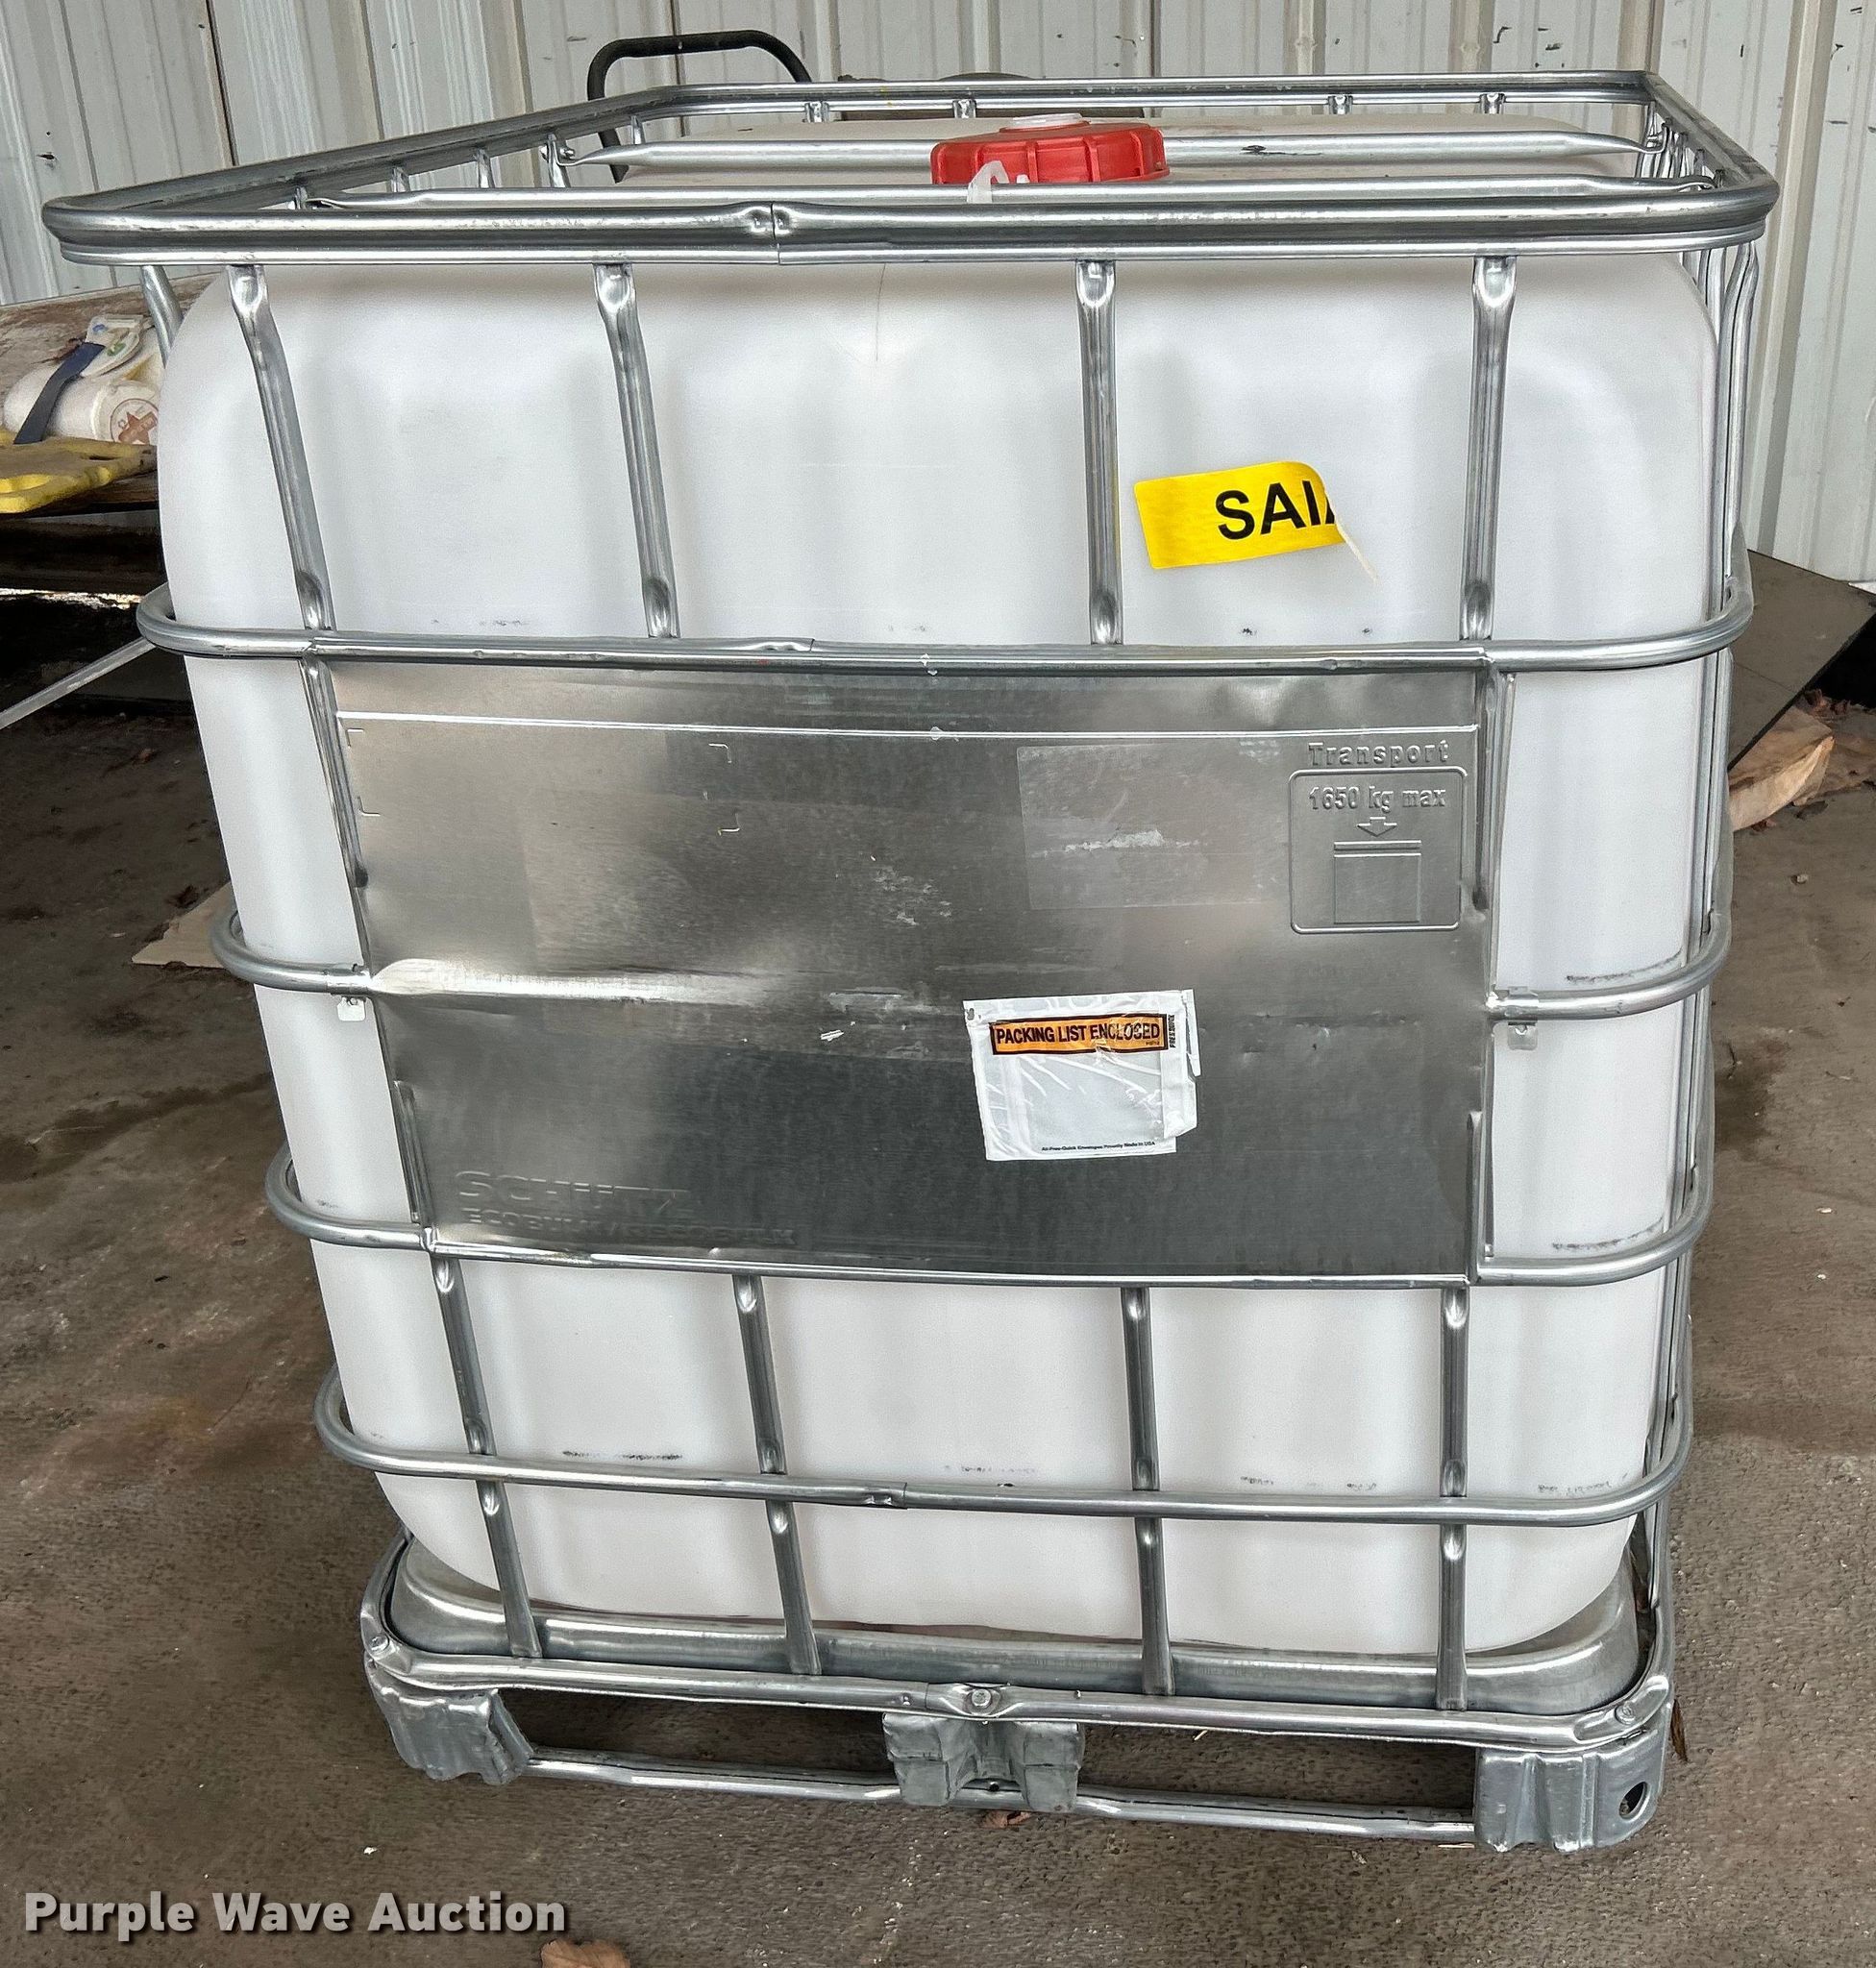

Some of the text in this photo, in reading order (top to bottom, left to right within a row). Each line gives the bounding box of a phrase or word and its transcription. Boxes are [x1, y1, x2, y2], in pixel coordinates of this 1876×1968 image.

[1215, 480, 1336, 540] SAI
[1308, 739, 1449, 768] Transport
[1309, 785, 1446, 813] 1650 kg max
[996, 1022, 1160, 1045] PACKING LIST ENCLOSED
